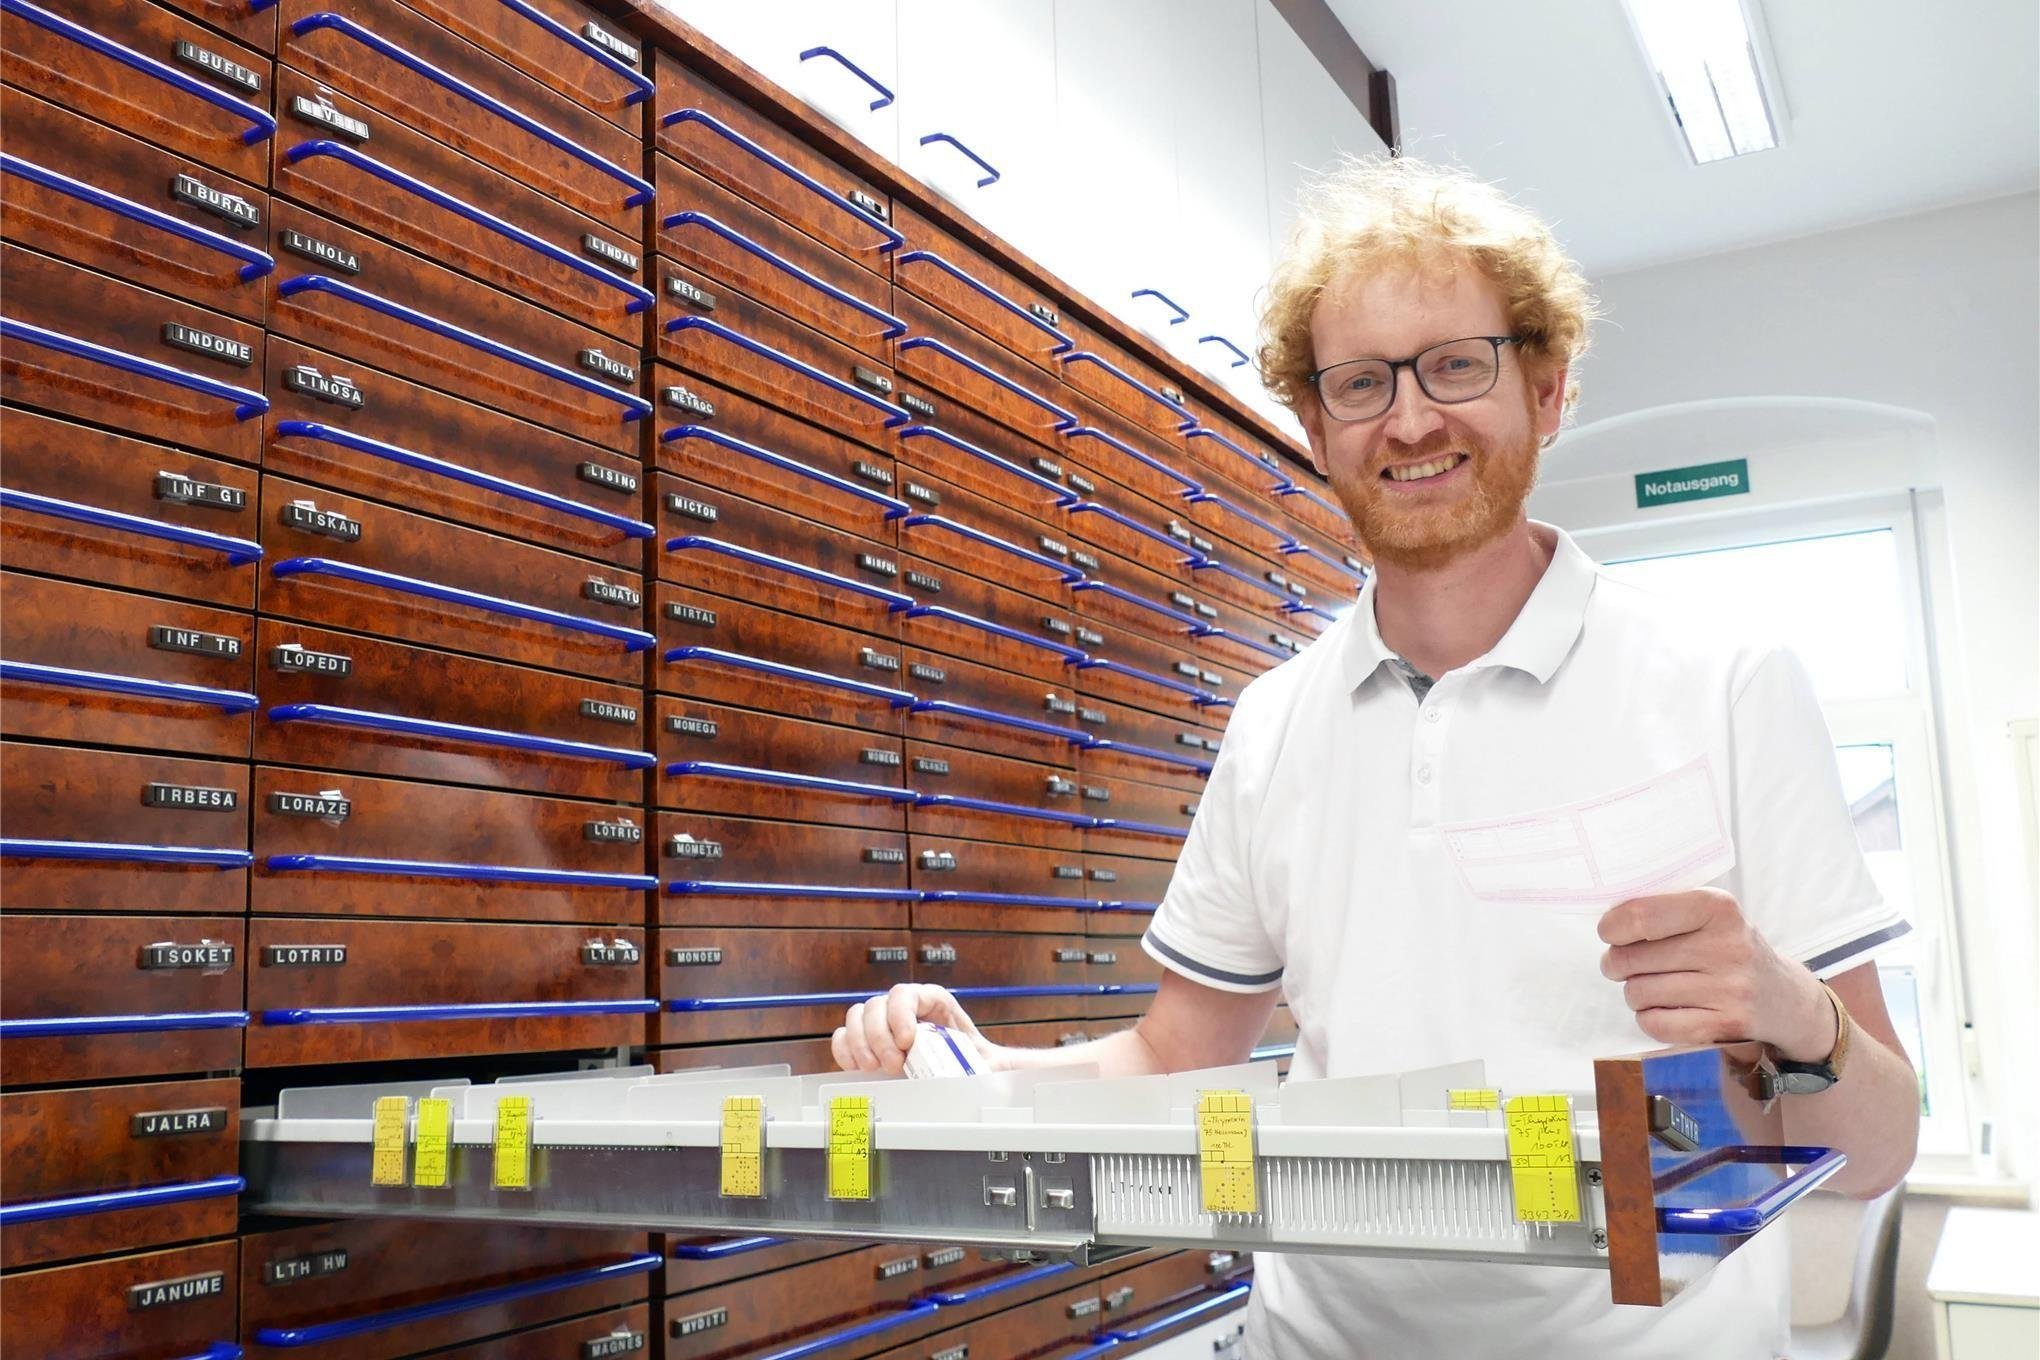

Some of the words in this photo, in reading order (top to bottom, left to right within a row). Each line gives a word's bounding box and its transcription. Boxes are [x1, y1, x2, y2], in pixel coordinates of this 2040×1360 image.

[187, 46, 258, 87] IBUFLA
[186, 182, 256, 220] IBURAT
[294, 235, 357, 268] LINOLA
[673, 279, 701, 300] METO
[178, 328, 250, 359] INDOME
[589, 353, 634, 379] LINOLA
[298, 373, 361, 402] LINOSA
[591, 466, 636, 488] LISINO
[1644, 474, 1738, 496] Notausgang
[173, 480, 205, 497] INF
[221, 491, 241, 504] GI
[674, 497, 716, 518] MICTON
[295, 508, 359, 535] LISKAN
[594, 585, 640, 603] LOMATU
[674, 605, 715, 624] MIRTAL
[167, 630, 199, 647] INF
[216, 638, 239, 654] TR
[284, 651, 347, 672] LOPEDI
[590, 702, 636, 720] LORANO
[674, 719, 716, 734] MOMEGA
[160, 790, 234, 807] IRBESA
[281, 797, 348, 815] LORAZE
[594, 825, 640, 839] LOTRIC
[158, 948, 232, 964] ISOKET
[276, 949, 344, 962] LOTRID
[591, 949, 615, 961] LTH
[623, 949, 639, 961] AB
[677, 952, 721, 963] MONOEM
[146, 1113, 211, 1133] JALRA
[275, 1261, 310, 1279] LTH
[324, 1253, 347, 1270] HW
[142, 1277, 221, 1306] JANUME
[591, 1335, 643, 1357] MAGNES
